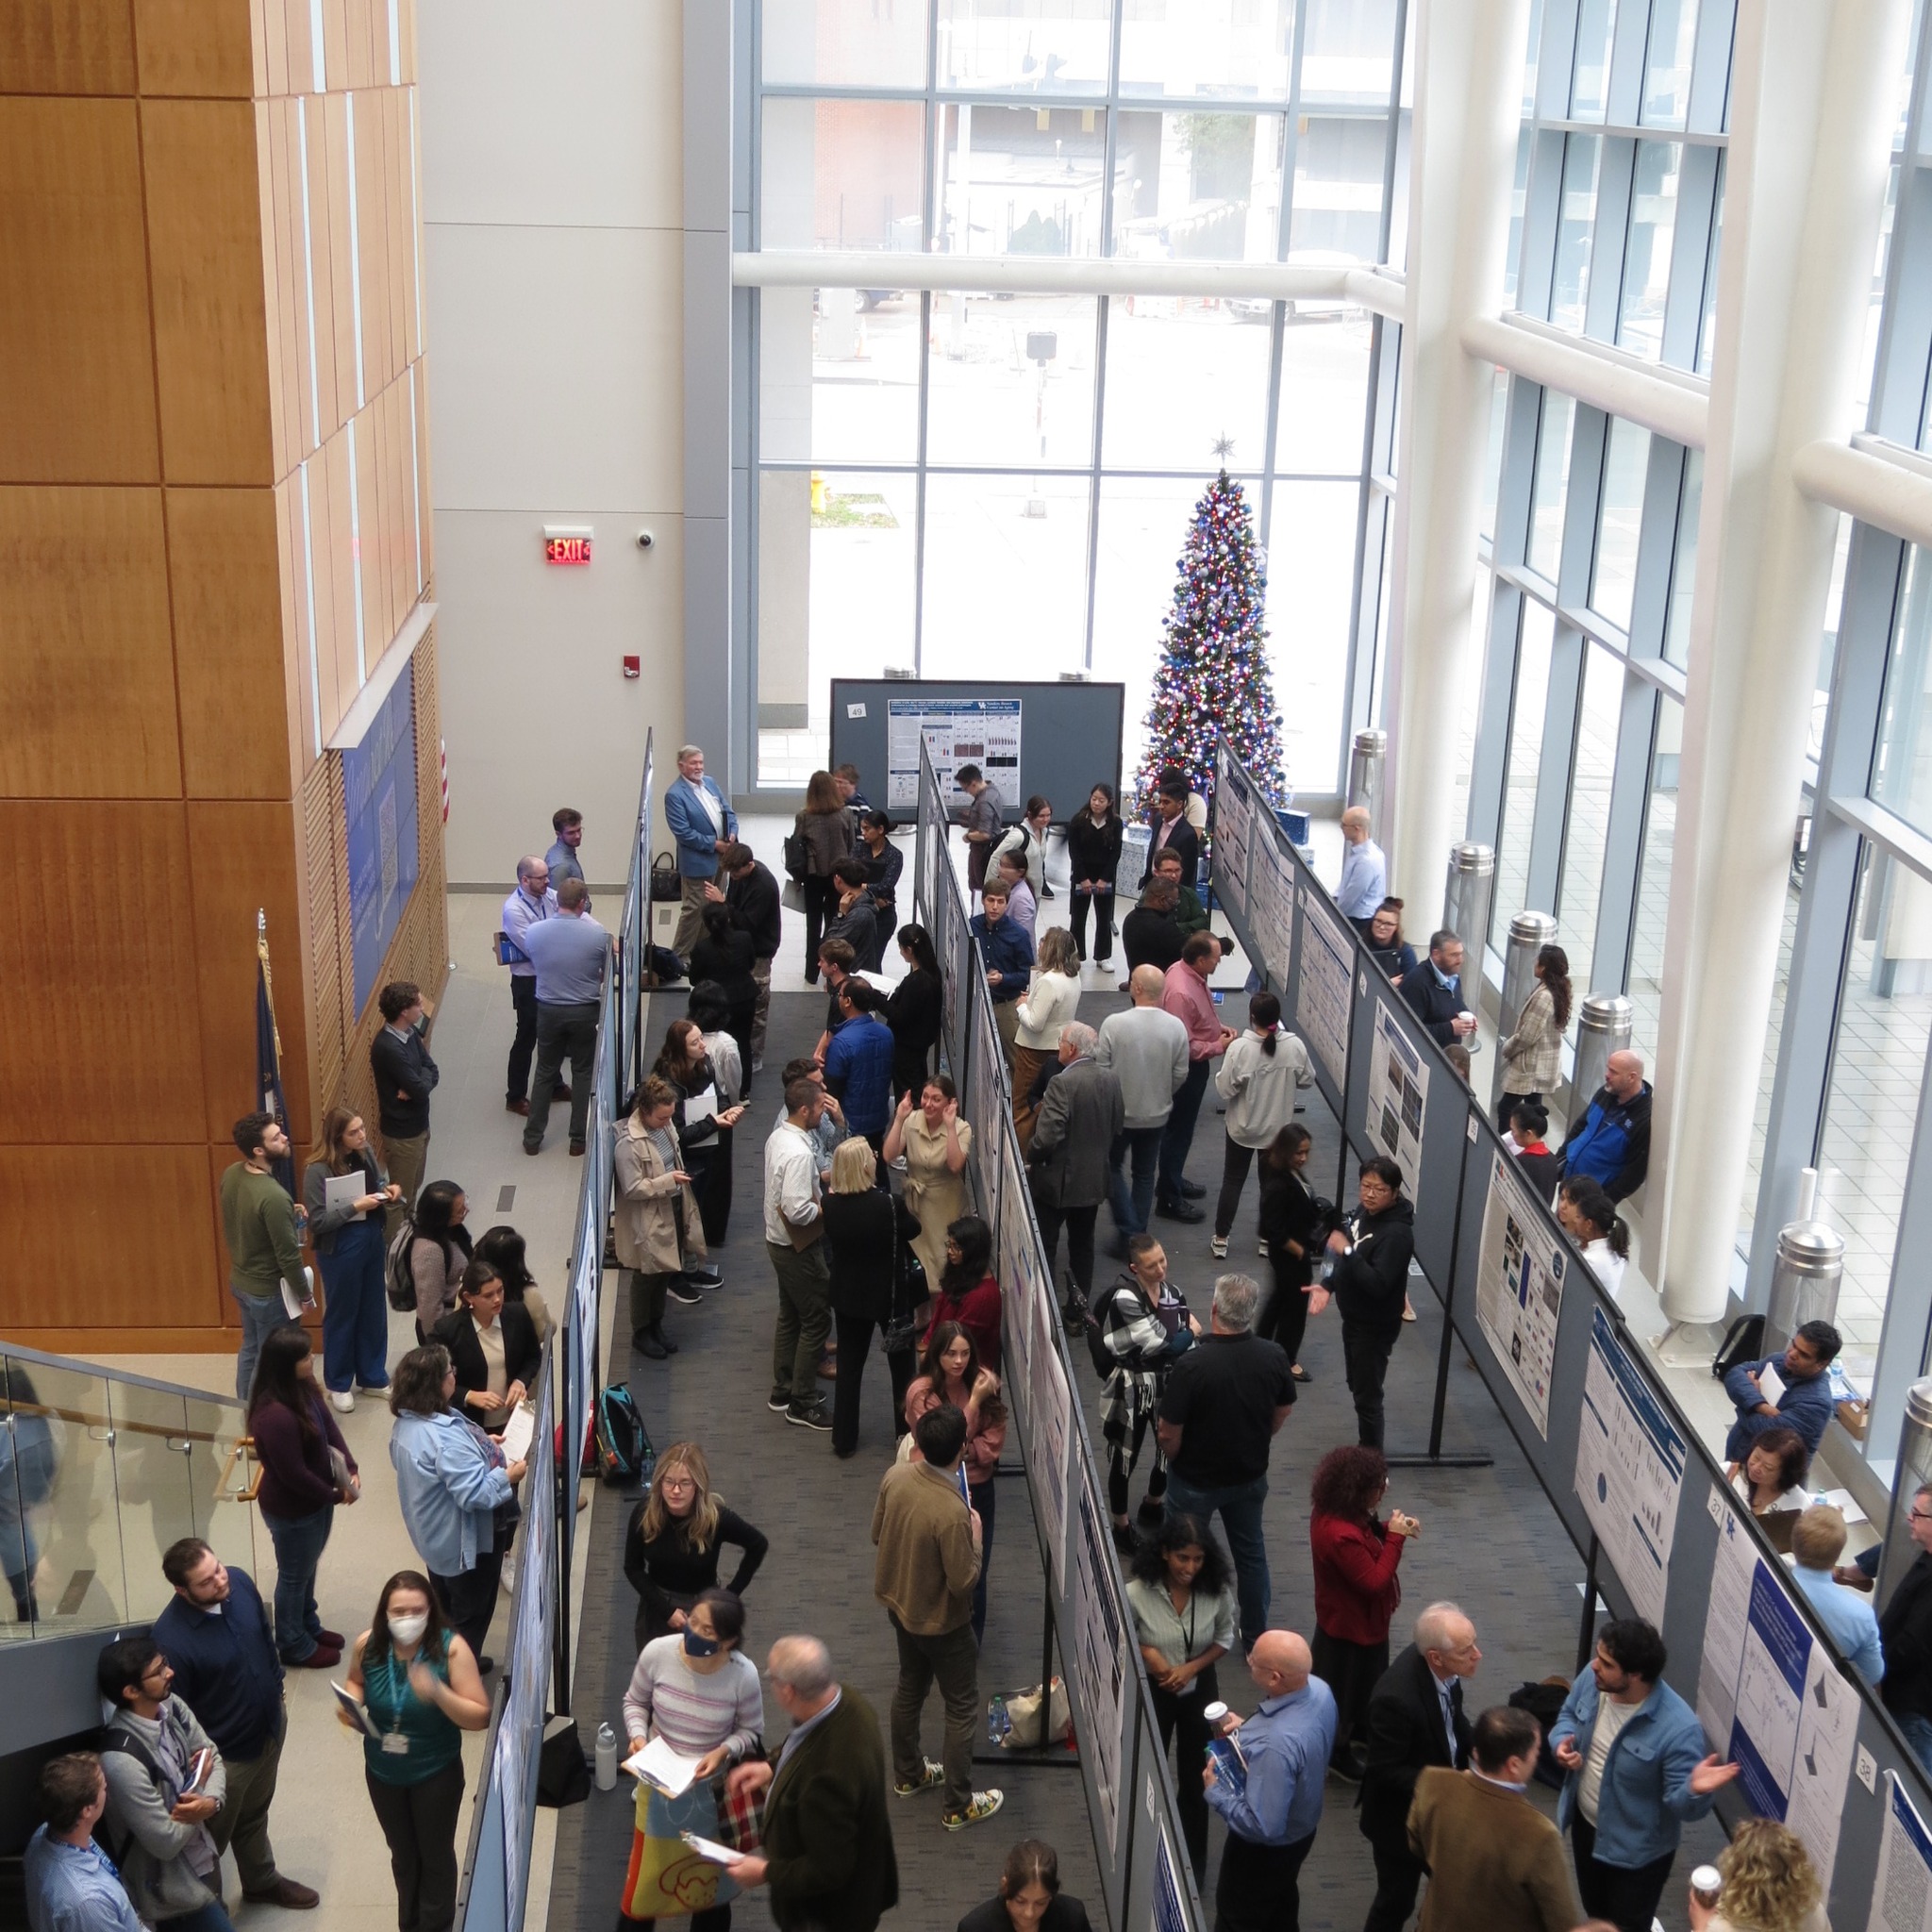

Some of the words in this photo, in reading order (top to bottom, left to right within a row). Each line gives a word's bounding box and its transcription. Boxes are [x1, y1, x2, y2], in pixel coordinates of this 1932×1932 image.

[554, 539, 583, 560] EXIT
[1711, 1498, 1721, 1517] 37
[1859, 1757, 1872, 1782] 38
